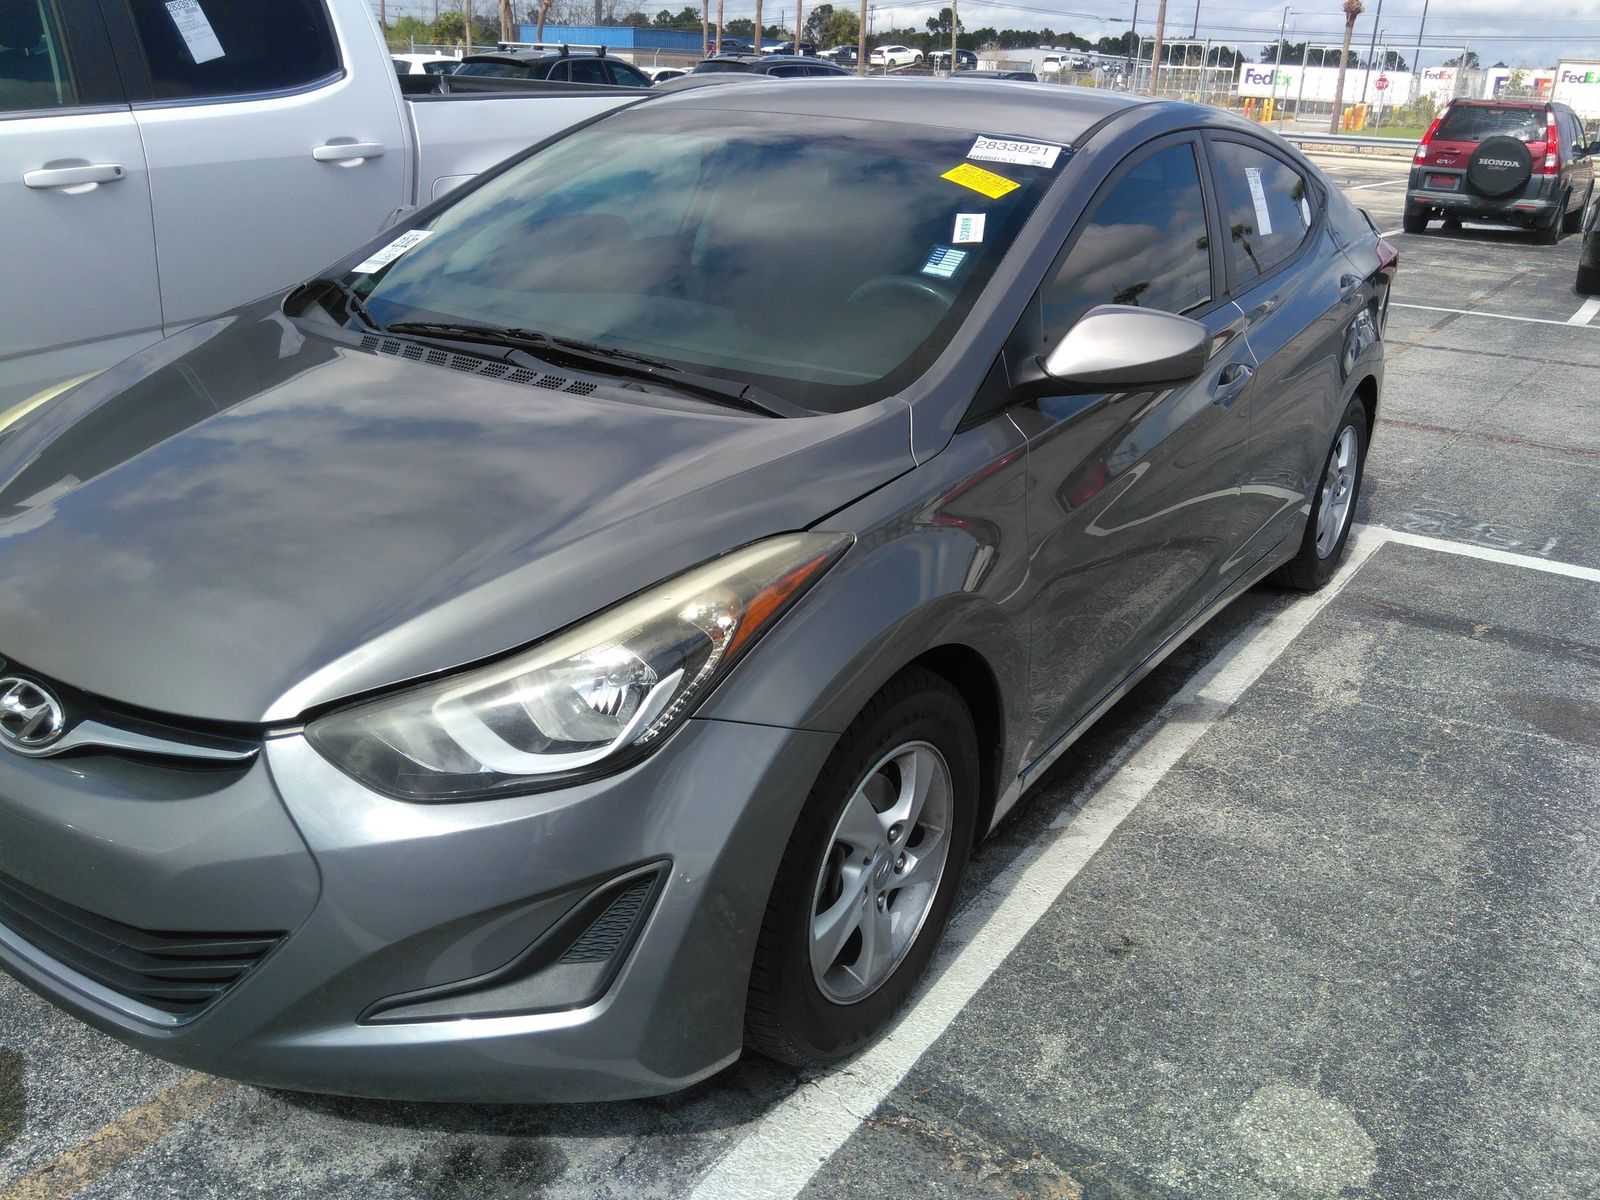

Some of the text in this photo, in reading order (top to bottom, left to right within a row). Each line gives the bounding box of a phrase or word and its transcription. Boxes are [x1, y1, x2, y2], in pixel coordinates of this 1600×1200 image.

[1245, 68, 1292, 86] FedEx
[1424, 70, 1453, 80] FedEx
[975, 141, 1049, 155] 2833921
[1478, 158, 1520, 167] HONDA
